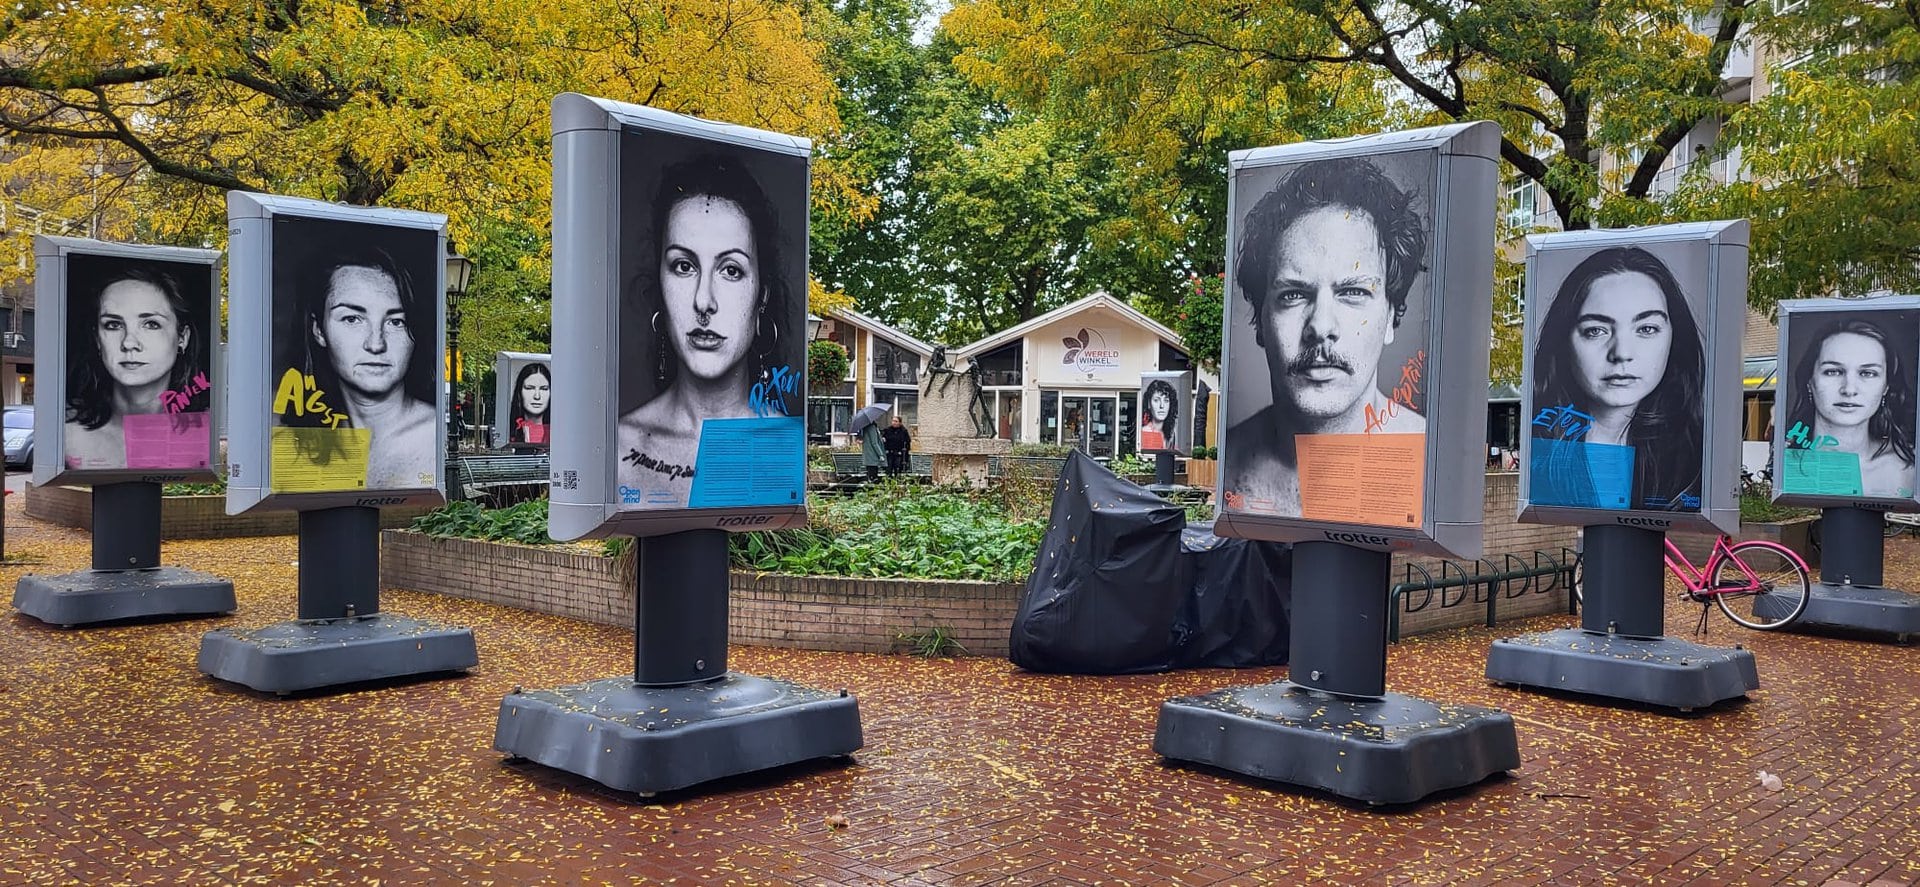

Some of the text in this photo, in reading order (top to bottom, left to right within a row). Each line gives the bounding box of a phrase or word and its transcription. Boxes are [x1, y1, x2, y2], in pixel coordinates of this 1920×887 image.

[619, 486, 640, 498] Open
[356, 497, 407, 505] trotter
[1853, 502, 1896, 511] trotter
[716, 514, 774, 526] trotter
[1617, 516, 1672, 527] trotter
[1324, 530, 1389, 545] trotter
